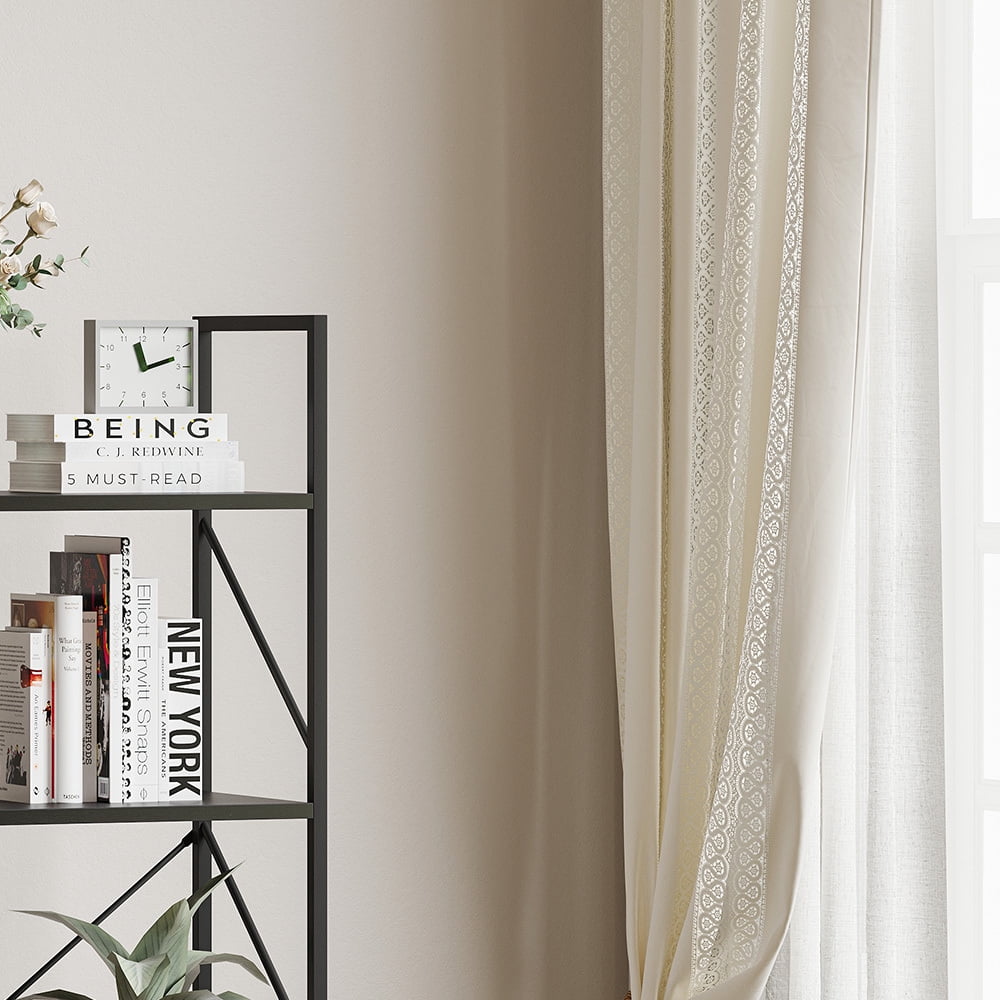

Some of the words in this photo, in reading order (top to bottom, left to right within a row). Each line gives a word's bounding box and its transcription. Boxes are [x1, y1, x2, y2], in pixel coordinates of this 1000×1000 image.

[74, 418, 210, 439] BEING
[96, 446, 110, 457] C.
[116, 446, 124, 458] J.
[132, 446, 204, 457] REDWINE
[67, 474, 76, 485] 5
[86, 473, 202, 485] MUST-READ
[137, 584, 151, 636] Elliott
[137, 646, 151, 700] Erwitt
[168, 622, 200, 695] NEW
[134, 709, 151, 776] Snaps
[168, 706, 201, 796] YORK
